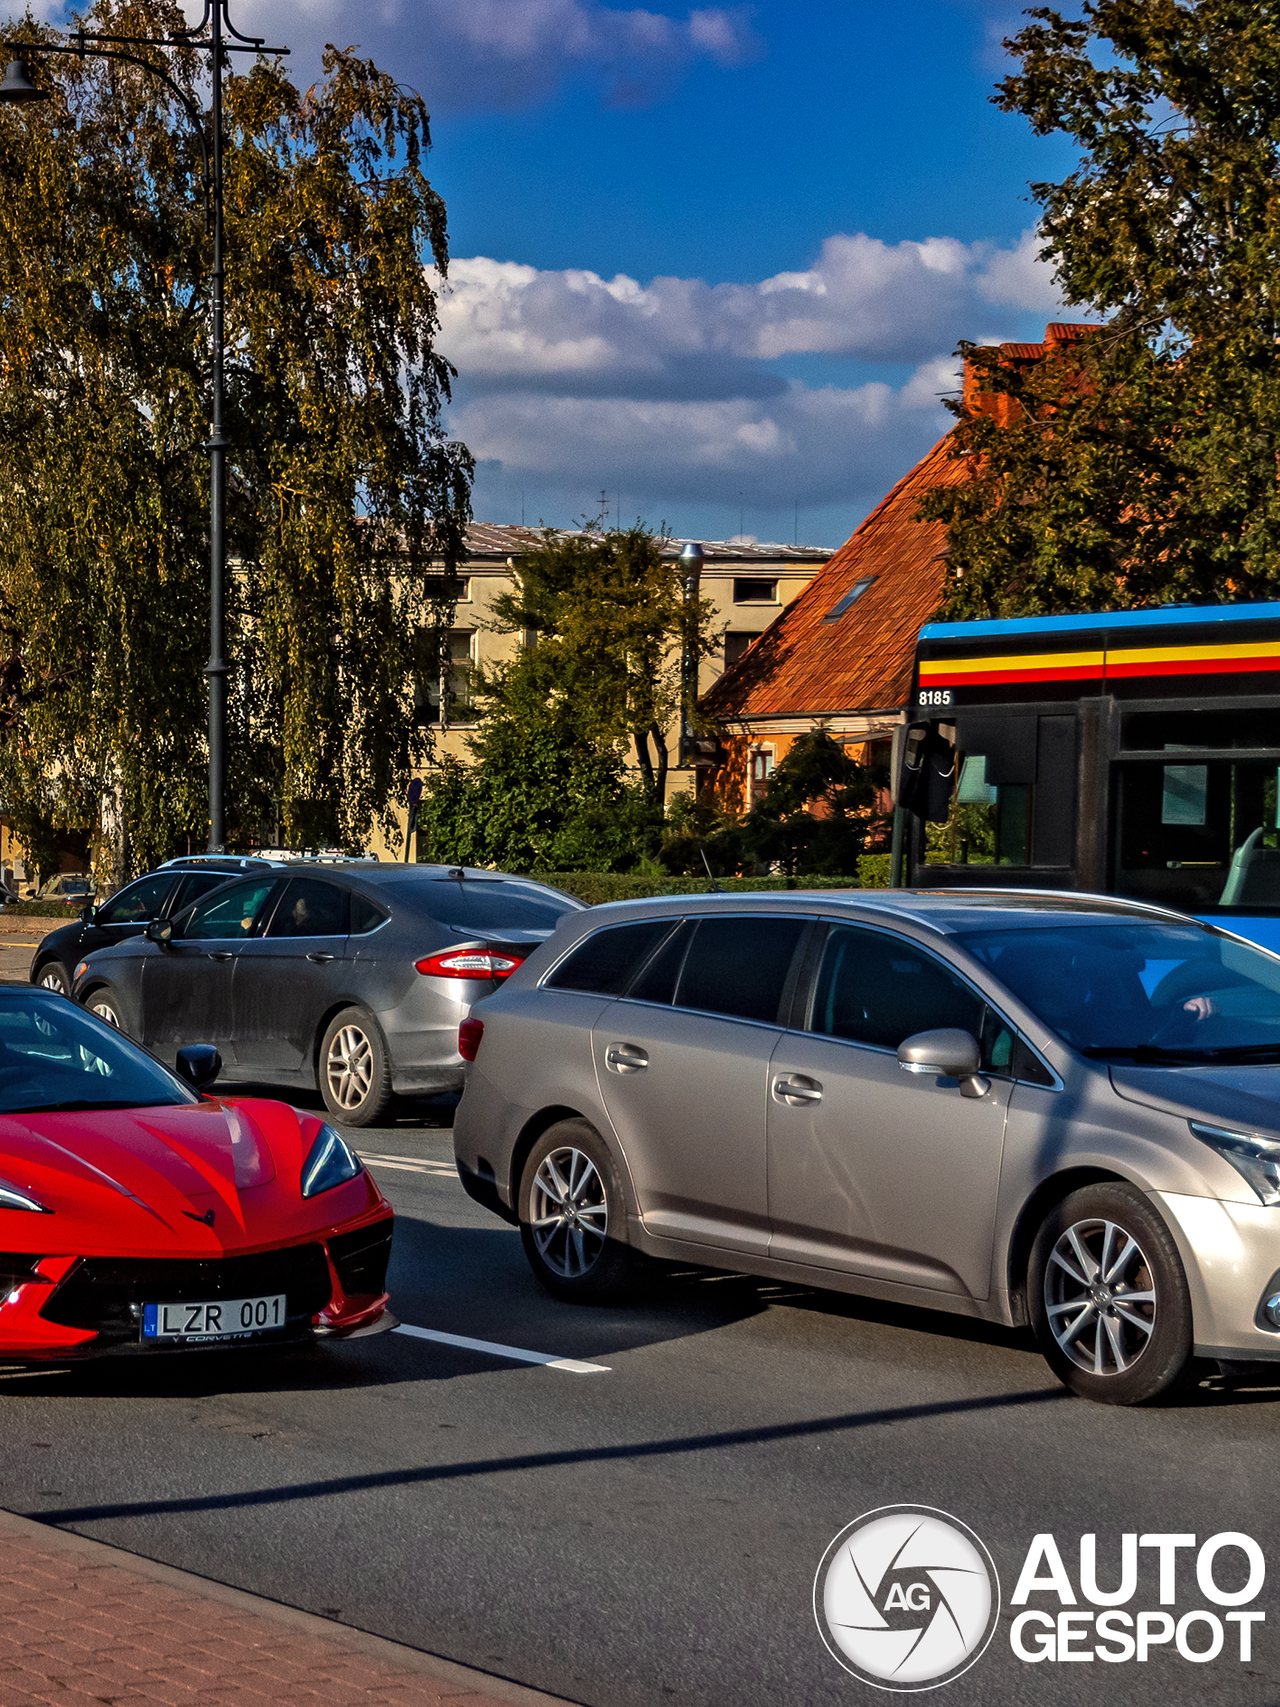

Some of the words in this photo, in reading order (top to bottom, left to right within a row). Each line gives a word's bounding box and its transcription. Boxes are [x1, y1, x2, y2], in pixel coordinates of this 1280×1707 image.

[919, 690, 951, 705] 8185
[162, 1305, 222, 1333] LZR
[240, 1298, 279, 1328] 001
[144, 1323, 156, 1332] LT
[185, 1331, 253, 1342] CORVETTE
